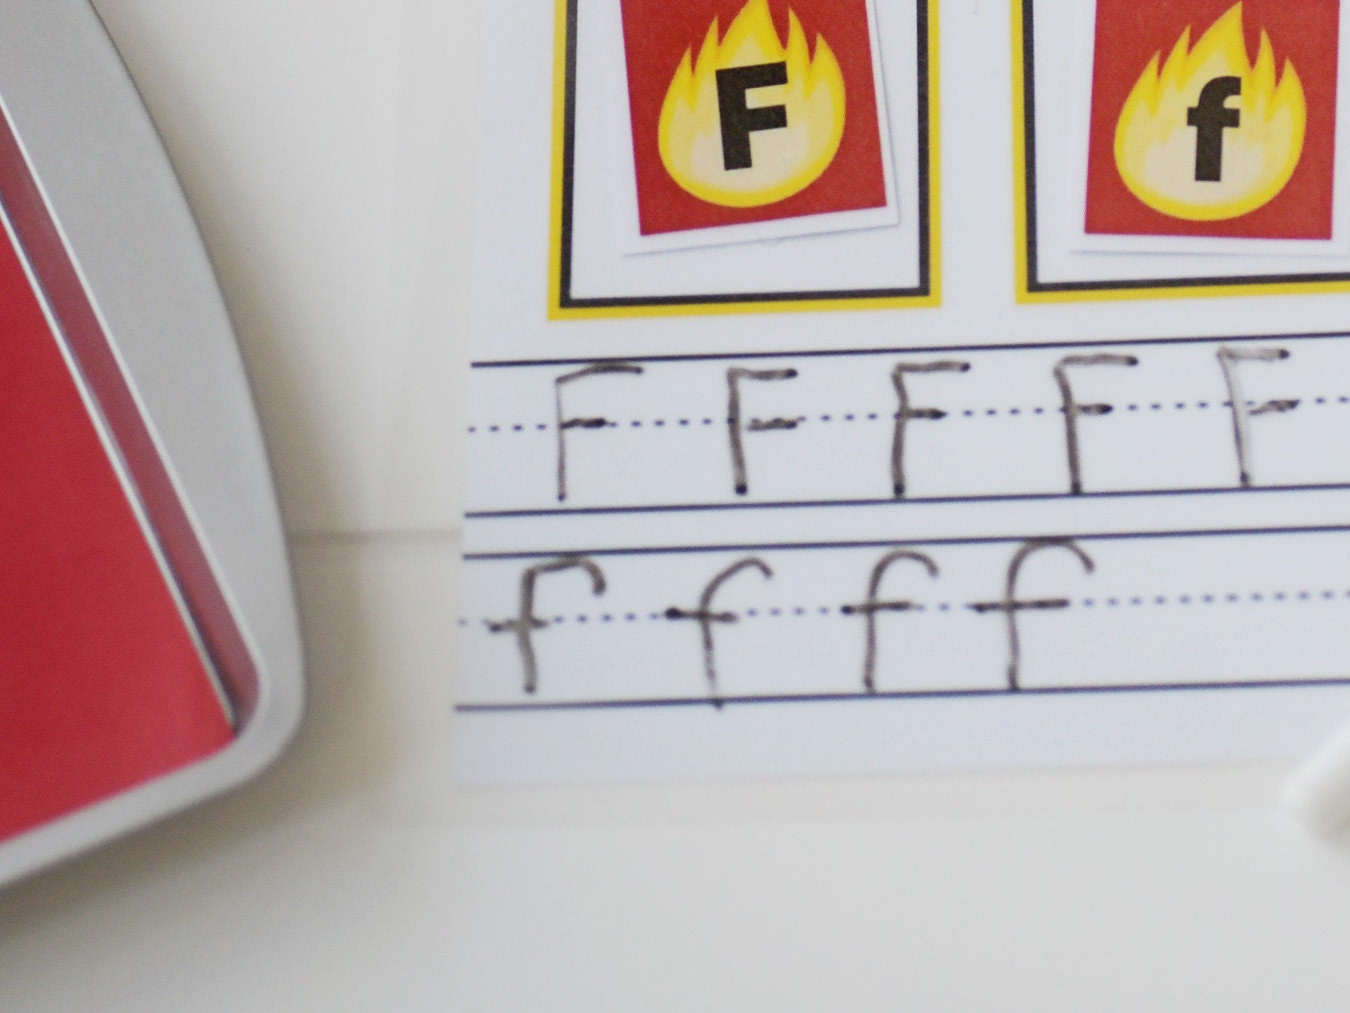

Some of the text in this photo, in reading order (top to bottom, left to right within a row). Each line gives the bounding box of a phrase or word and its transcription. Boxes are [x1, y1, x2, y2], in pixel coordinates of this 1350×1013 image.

[716, 62, 788, 170] F
[1187, 76, 1241, 181] f
[555, 348, 1299, 500] F F F F F
[484, 539, 1095, 710] f f f f
